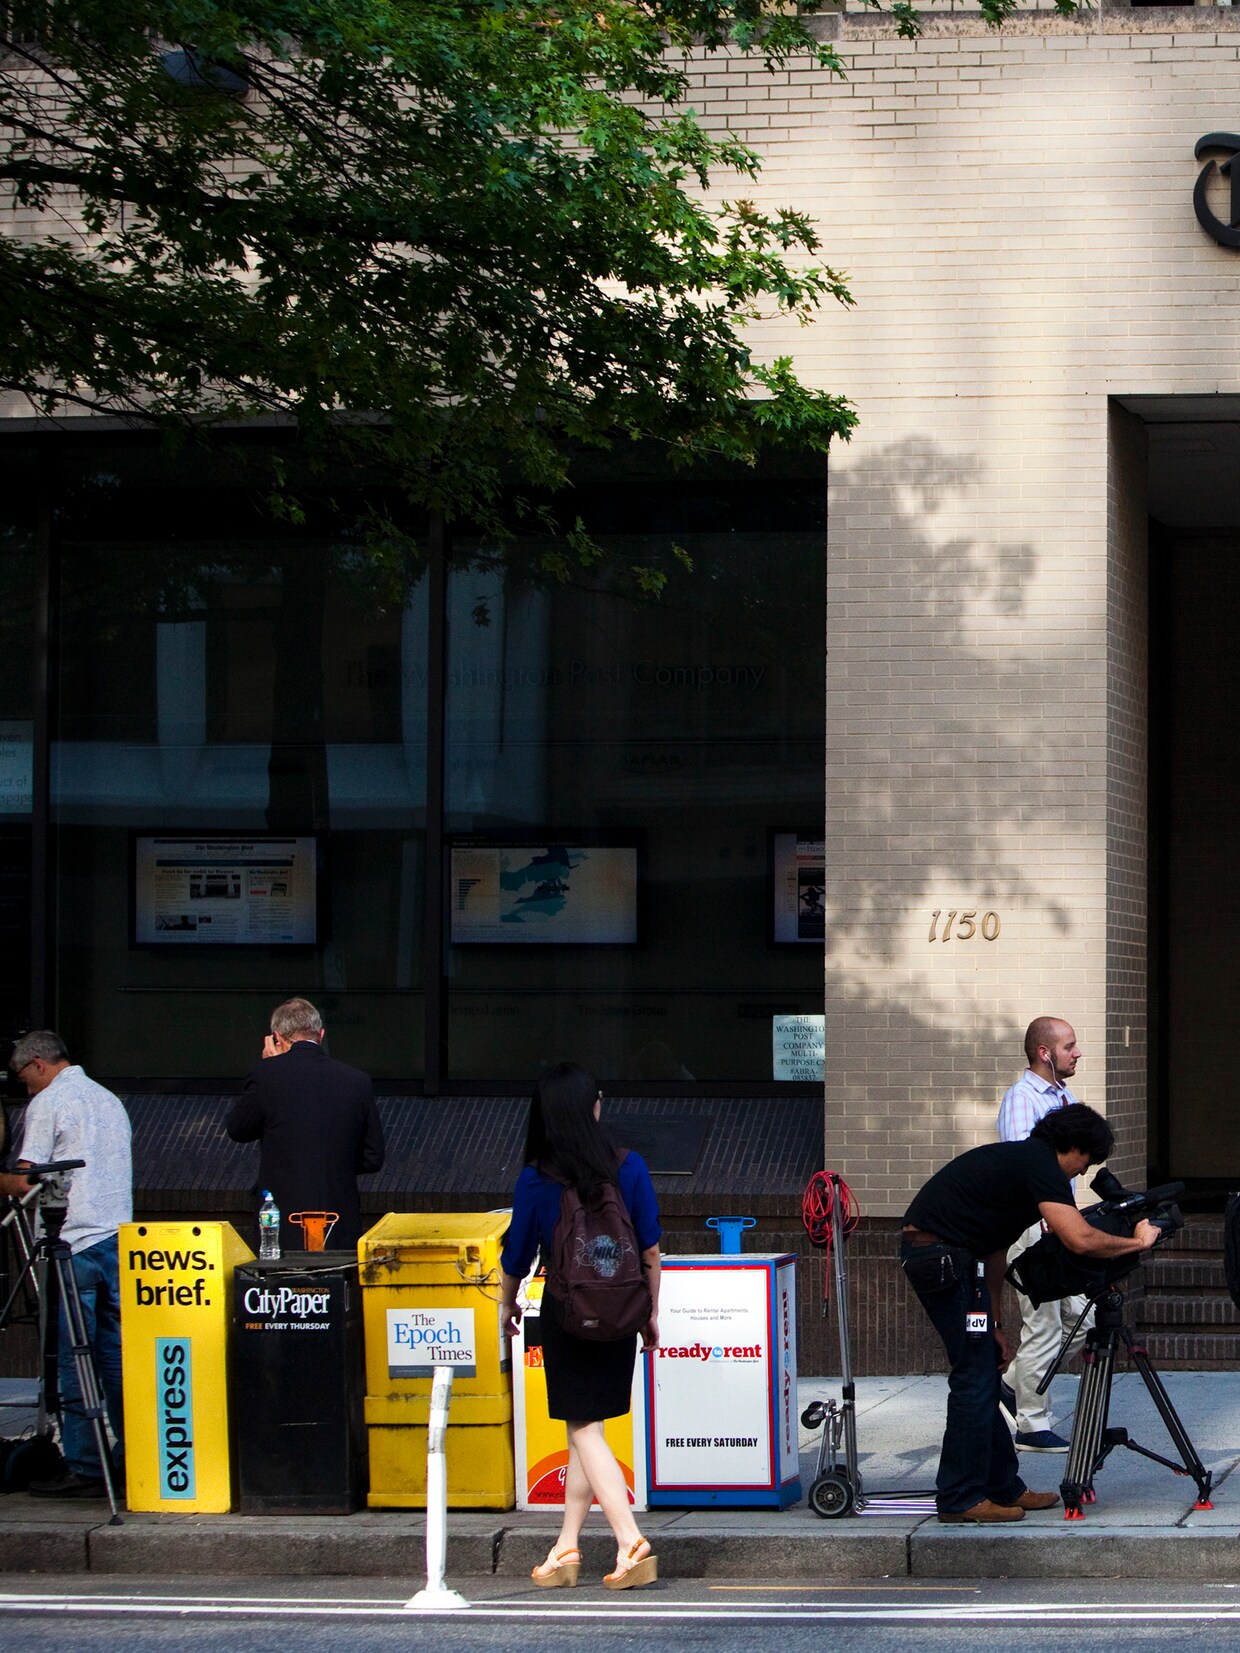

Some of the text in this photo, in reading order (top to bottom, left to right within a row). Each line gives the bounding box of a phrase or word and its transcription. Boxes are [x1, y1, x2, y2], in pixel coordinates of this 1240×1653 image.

[401, 659, 558, 692] Wshington
[570, 659, 622, 686] Post
[632, 660, 768, 692] Company
[928, 910, 1001, 943] 1150
[793, 1032, 814, 1040] POST
[783, 1042, 824, 1050] COMPANY
[593, 1245, 621, 1259] NIKE
[129, 1250, 215, 1271] news.
[136, 1278, 211, 1306] brief.
[245, 1322, 331, 1330] FREE EVERY THURSDAY
[411, 1313, 436, 1326] The
[393, 1321, 462, 1350] Epoch
[427, 1346, 473, 1361] Times
[658, 1343, 713, 1361] ready
[723, 1344, 762, 1358] rent
[162, 1344, 193, 1492] express
[665, 1437, 758, 1448] FREE EVERY SATURDAY
